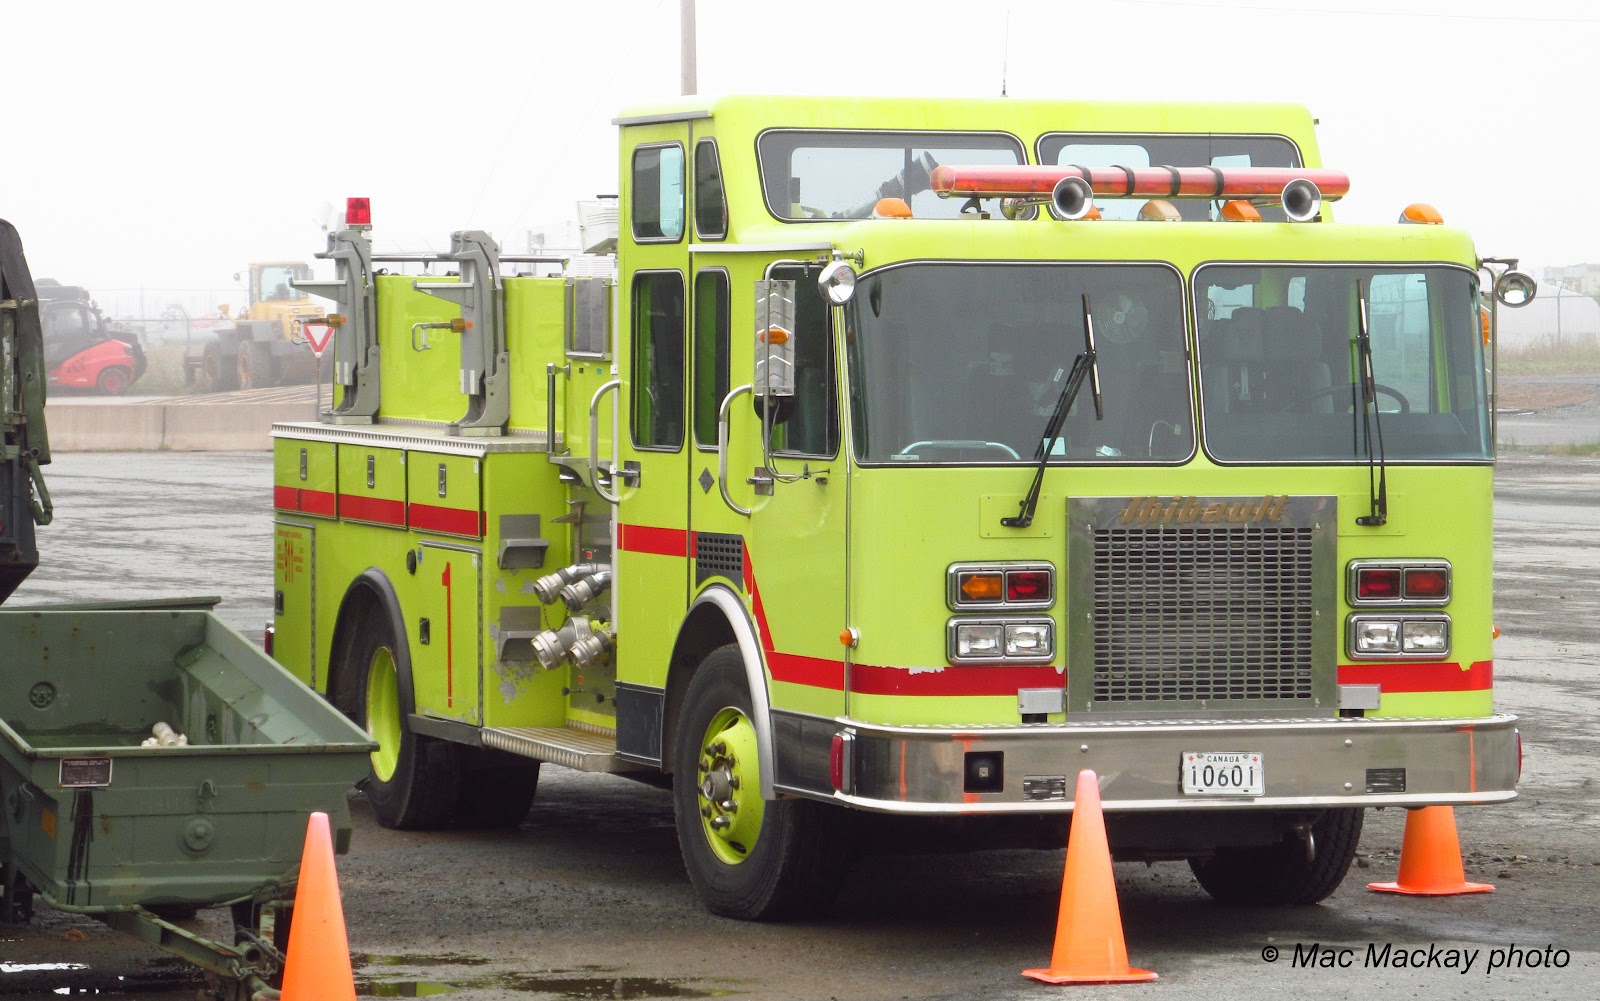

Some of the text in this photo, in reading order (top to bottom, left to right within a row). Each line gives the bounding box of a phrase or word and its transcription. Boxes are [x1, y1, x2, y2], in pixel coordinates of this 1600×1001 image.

[1120, 494, 1289, 524] Thibault
[441, 561, 453, 708] 1
[1206, 755, 1240, 763] CANADA
[1191, 764, 1254, 787] 10601
